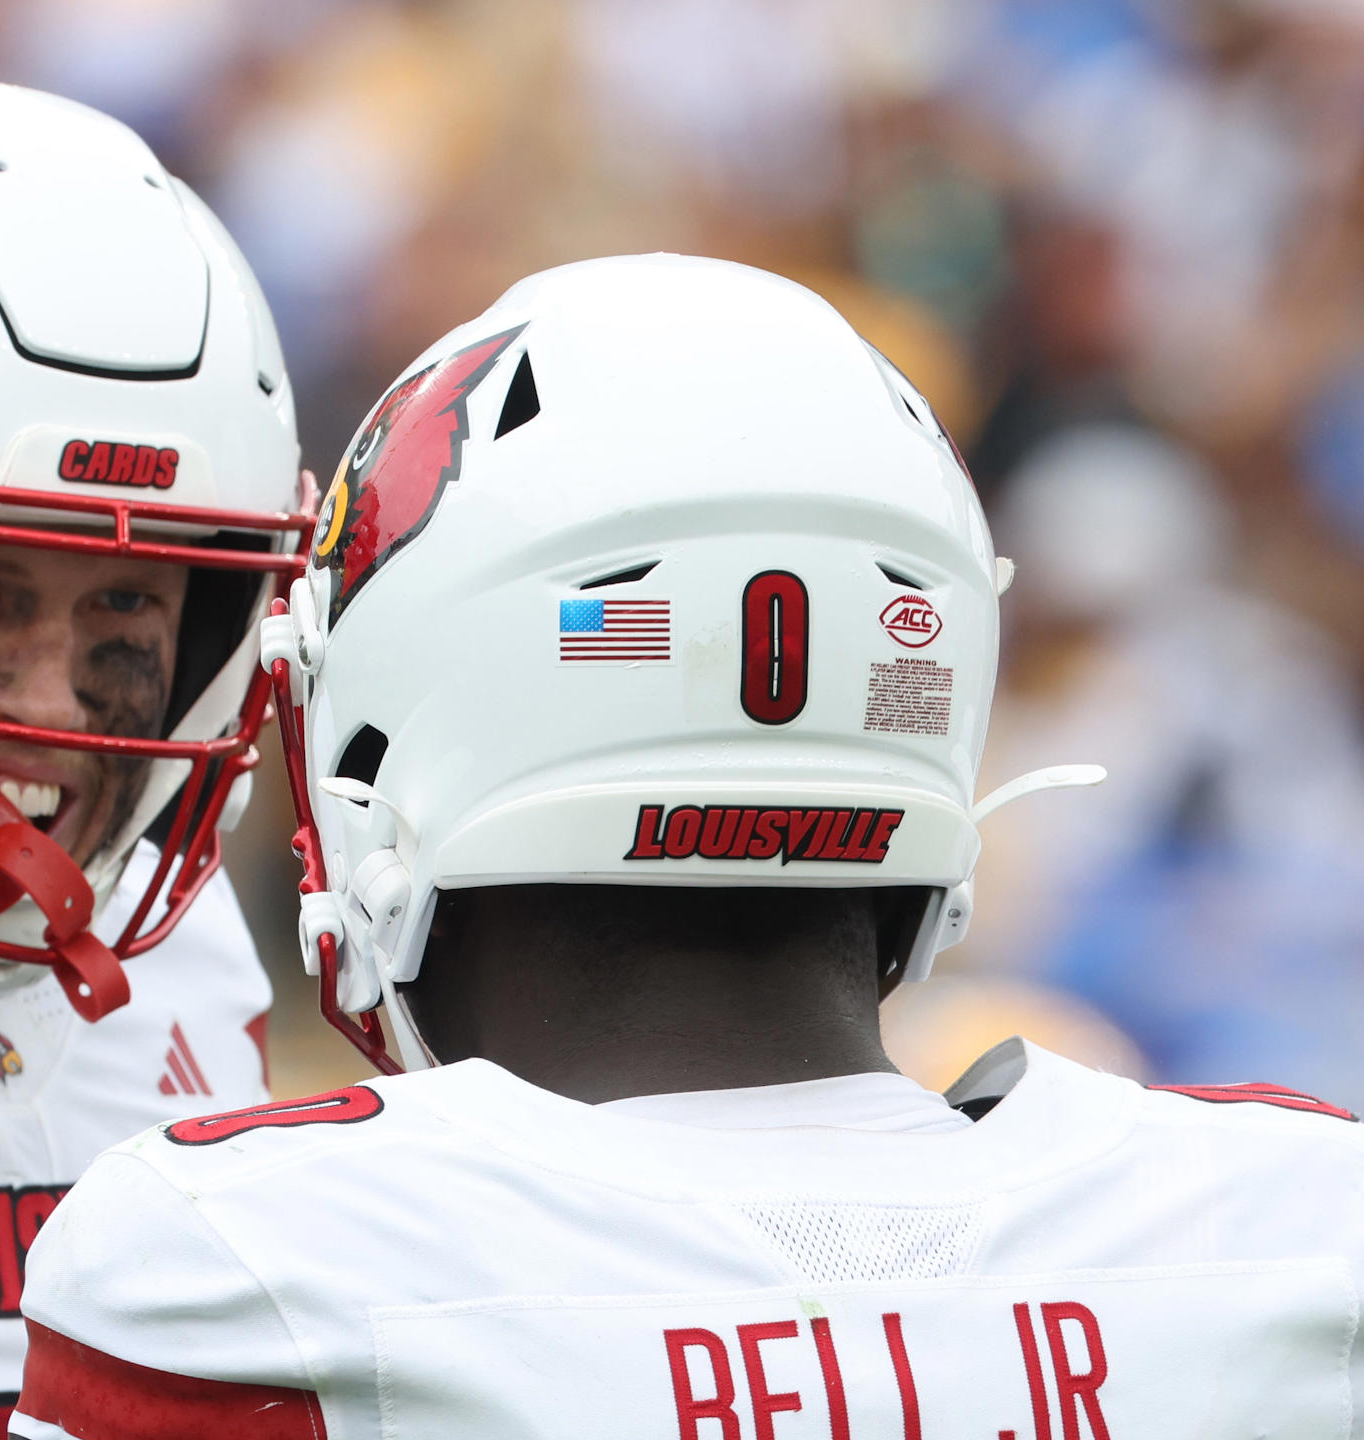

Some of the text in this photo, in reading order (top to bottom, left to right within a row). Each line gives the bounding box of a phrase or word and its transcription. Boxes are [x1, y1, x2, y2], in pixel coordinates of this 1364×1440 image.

[58, 439, 180, 489] CARDS
[890, 607, 934, 628] ACC
[740, 569, 810, 725] 0
[895, 657, 937, 667] WARNING
[623, 804, 905, 866] LOUISVILLE
